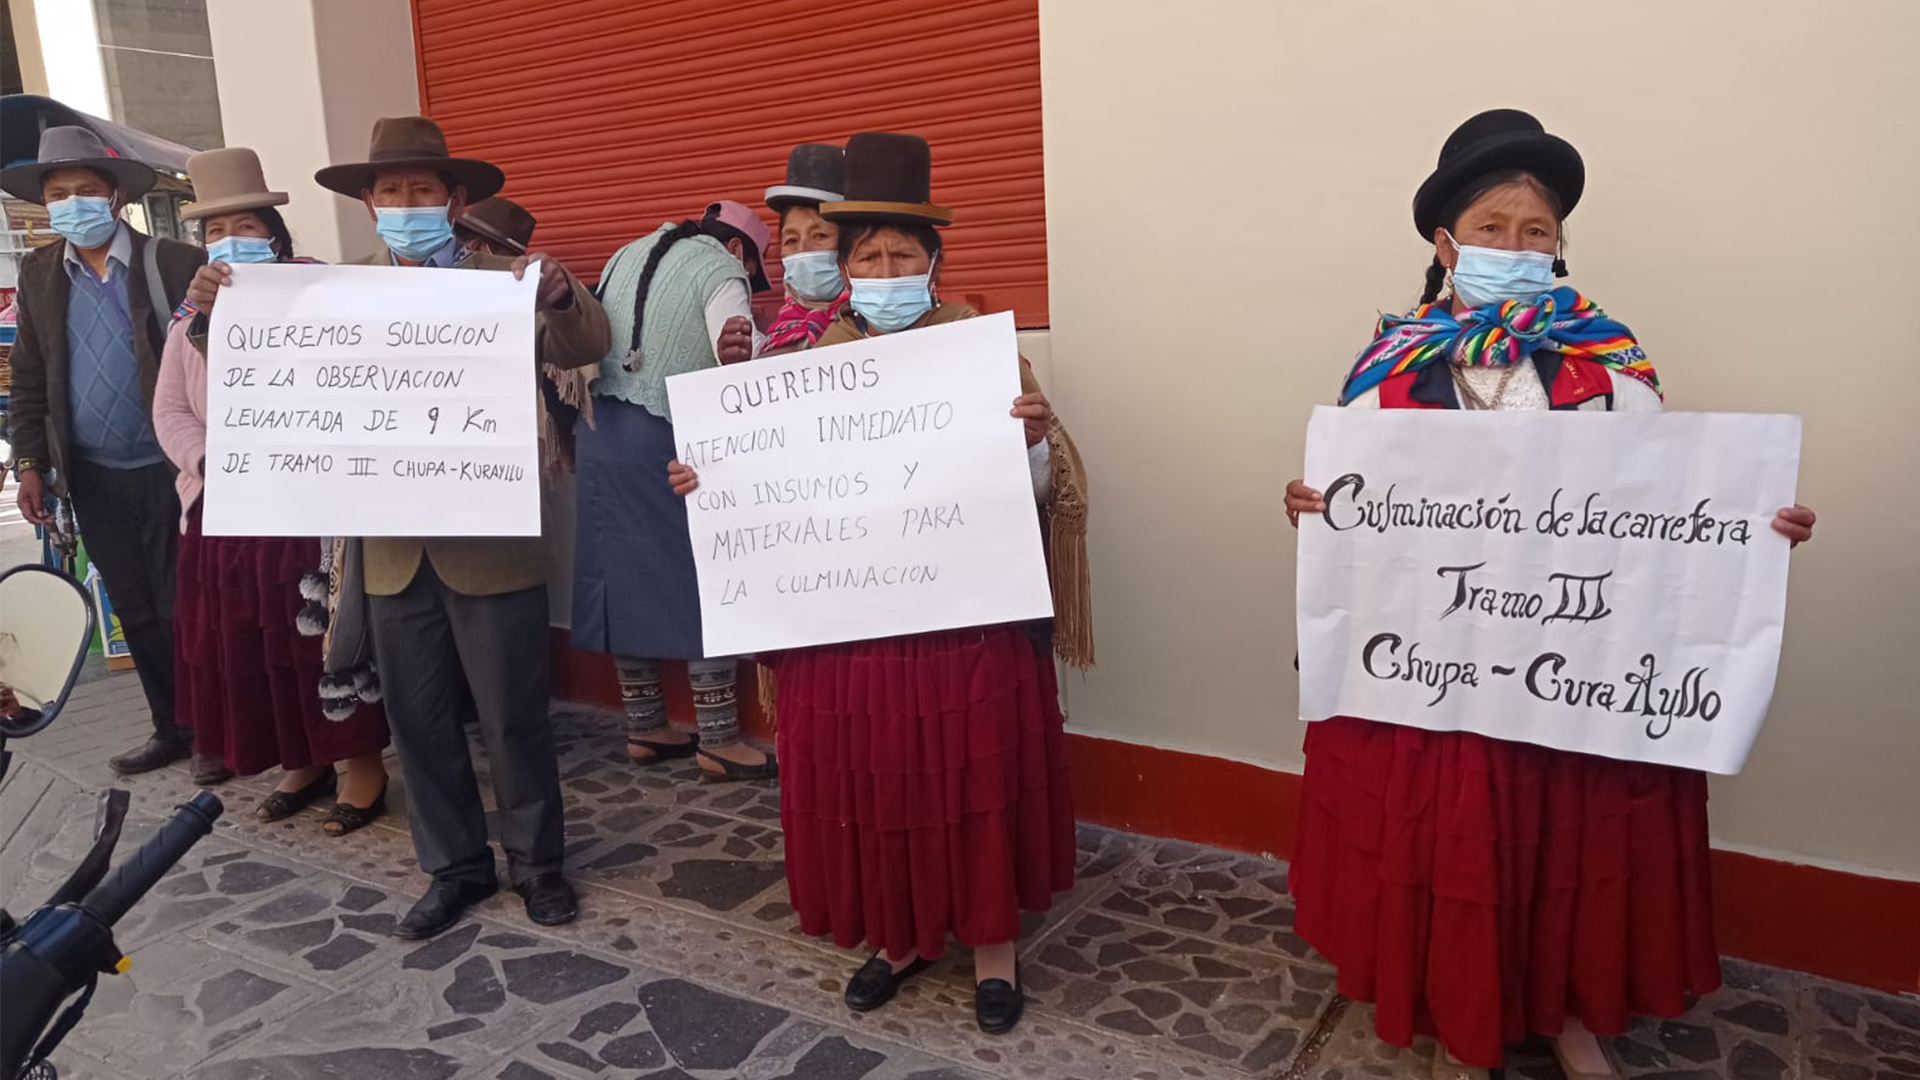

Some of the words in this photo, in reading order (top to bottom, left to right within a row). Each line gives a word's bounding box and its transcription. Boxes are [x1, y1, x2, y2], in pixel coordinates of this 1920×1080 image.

[227, 324, 362, 351] QUEREMOS
[386, 322, 499, 347] SOLUCION
[223, 367, 256, 387] DE
[268, 368, 294, 387] LA
[316, 365, 465, 391] OBSERVACION
[720, 359, 880, 414] QUEREMOS
[225, 407, 343, 433] LEVANTADA
[363, 410, 399, 431] DE
[428, 407, 439, 434] 9
[462, 406, 497, 433] Km
[683, 426, 785, 469] ATENCION
[817, 401, 953, 443] INMEDIATO
[222, 453, 251, 473] DE
[269, 454, 333, 474] TRAMO
[347, 458, 378, 476] III
[697, 490, 737, 511] CON
[753, 472, 868, 506] INSUMOS
[903, 461, 919, 490] Y
[1323, 473, 1528, 533] Culminación
[1536, 488, 1573, 537] de
[712, 517, 868, 561] MATERIALES
[902, 503, 965, 538] PARA
[721, 579, 748, 606] LA
[776, 565, 938, 594] CULMINACION
[1437, 562, 1542, 620] Tramo
[1541, 571, 1613, 626] III
[1363, 633, 1479, 707] Chupa
[1525, 652, 1616, 711] Cura
